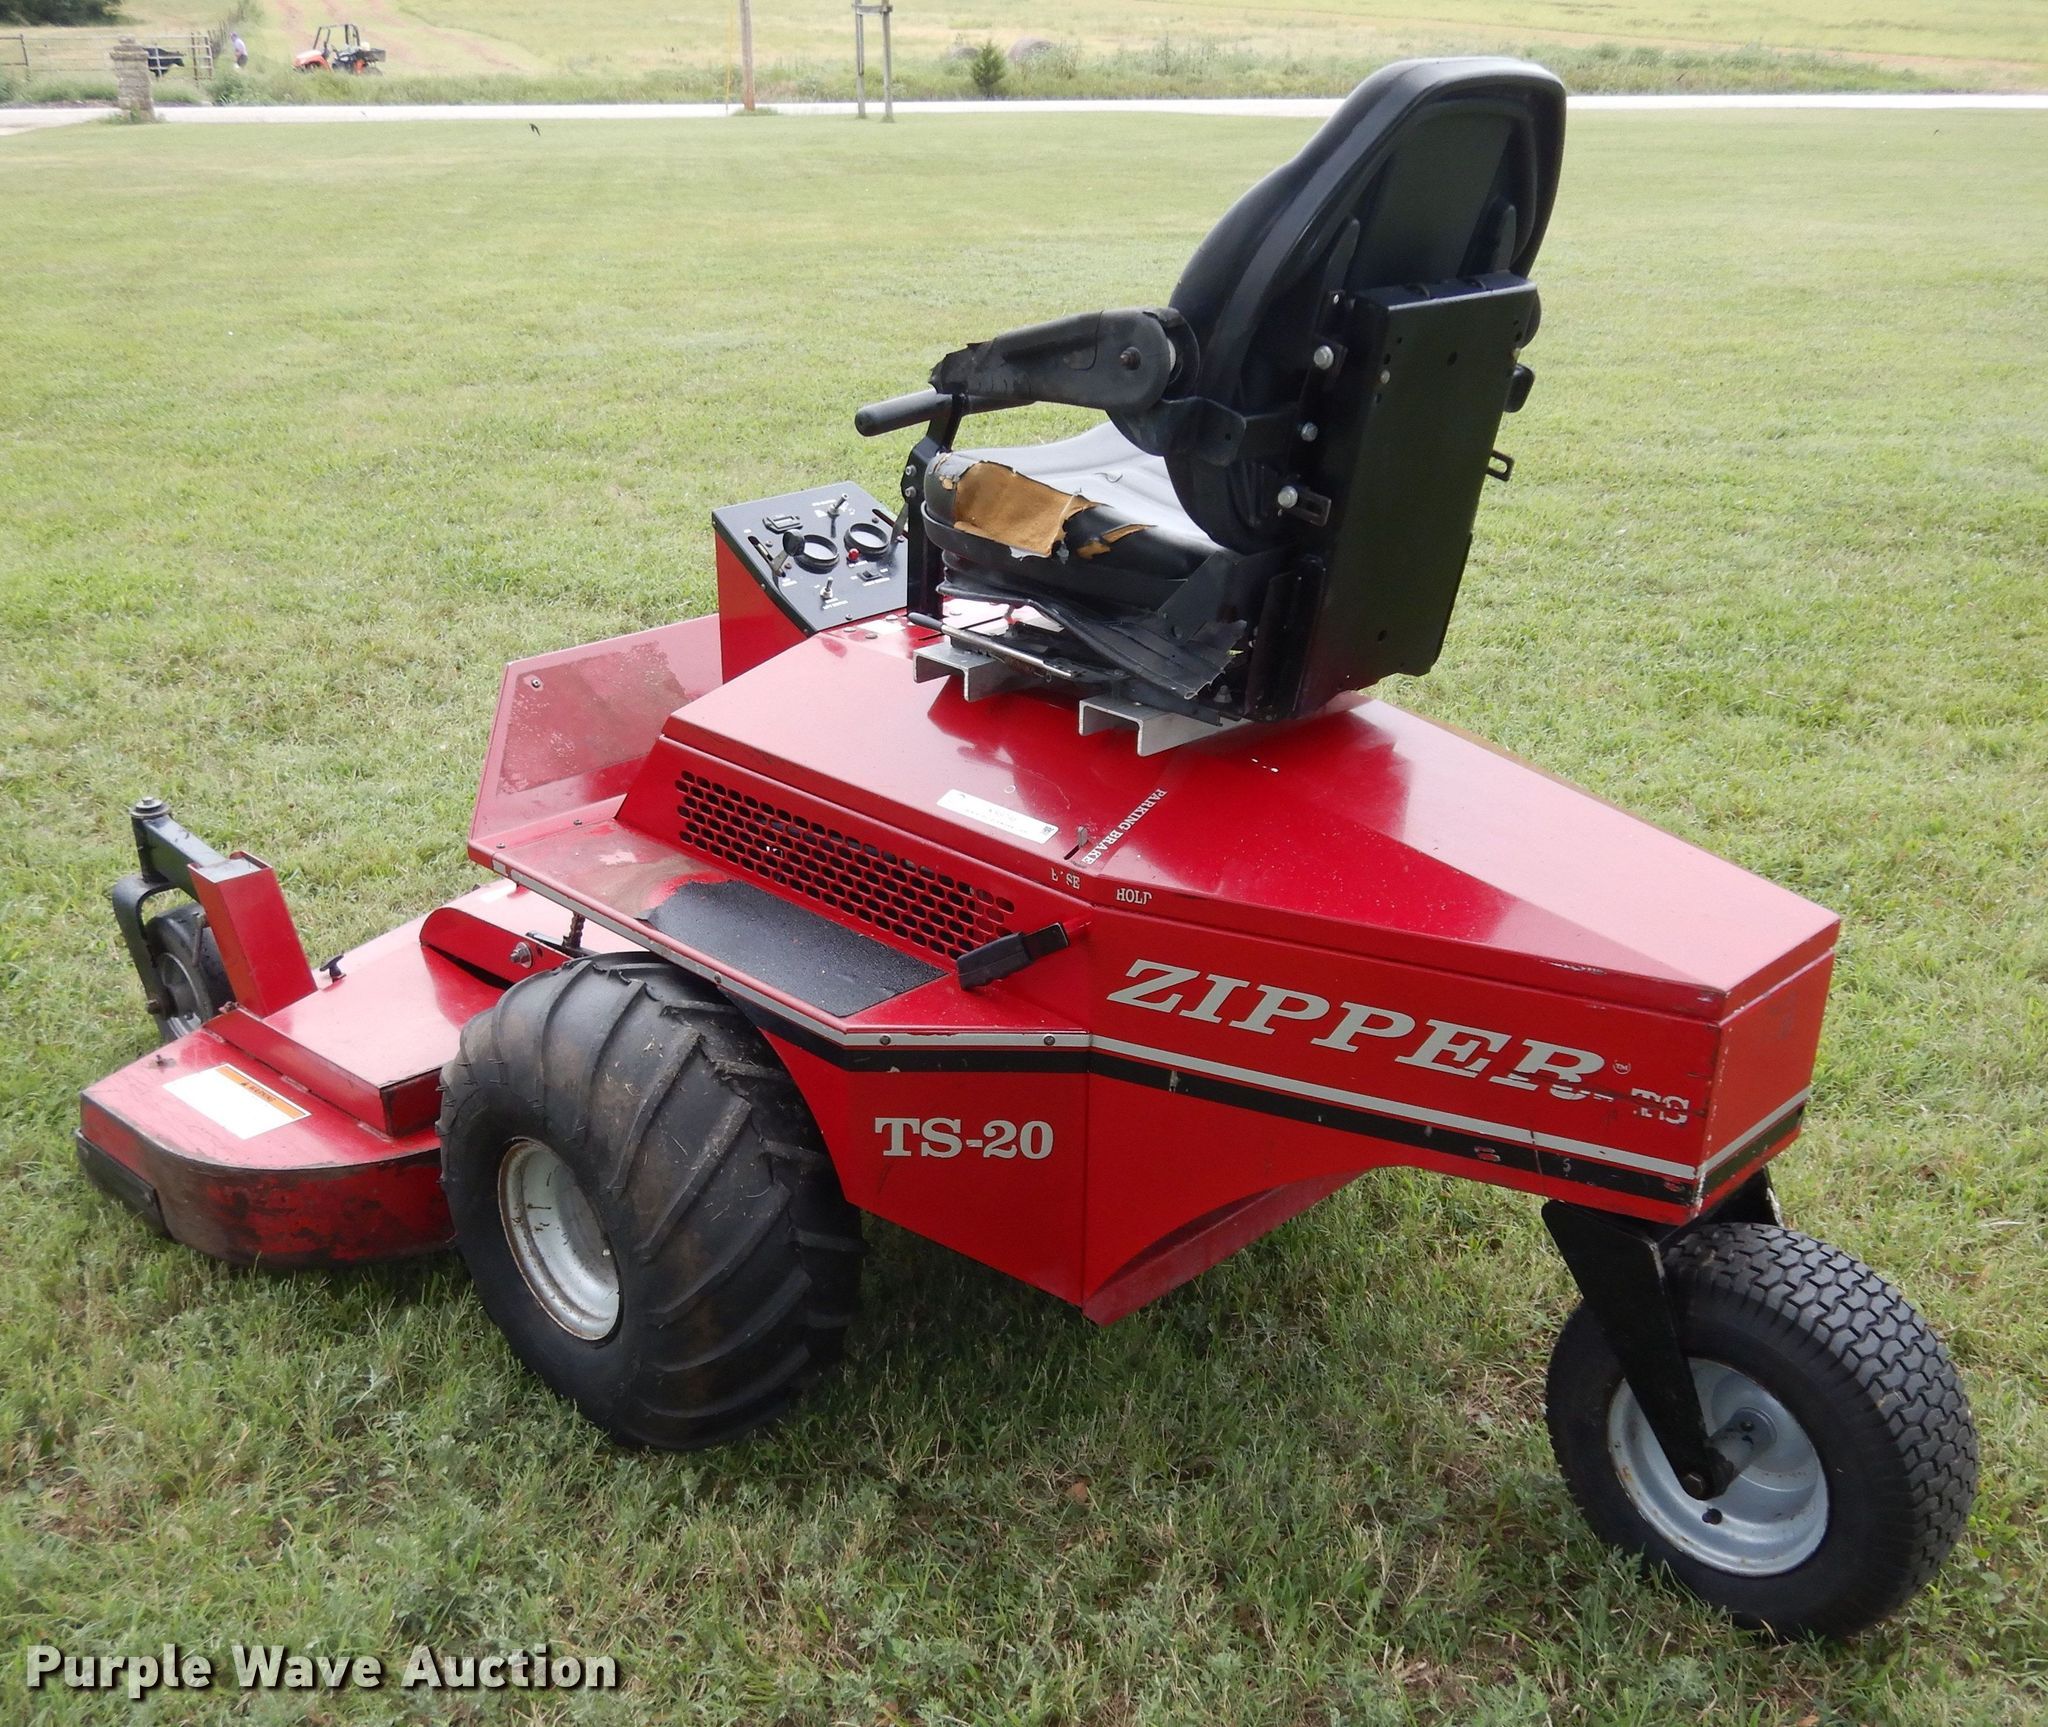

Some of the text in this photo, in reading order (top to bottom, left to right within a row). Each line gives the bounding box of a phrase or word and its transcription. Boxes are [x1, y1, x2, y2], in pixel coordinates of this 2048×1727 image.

[1081, 788, 1168, 865] PARKING BRAKE
[1106, 958, 1605, 1101] ZIPPER
[874, 1117, 1054, 1160] TS-20
